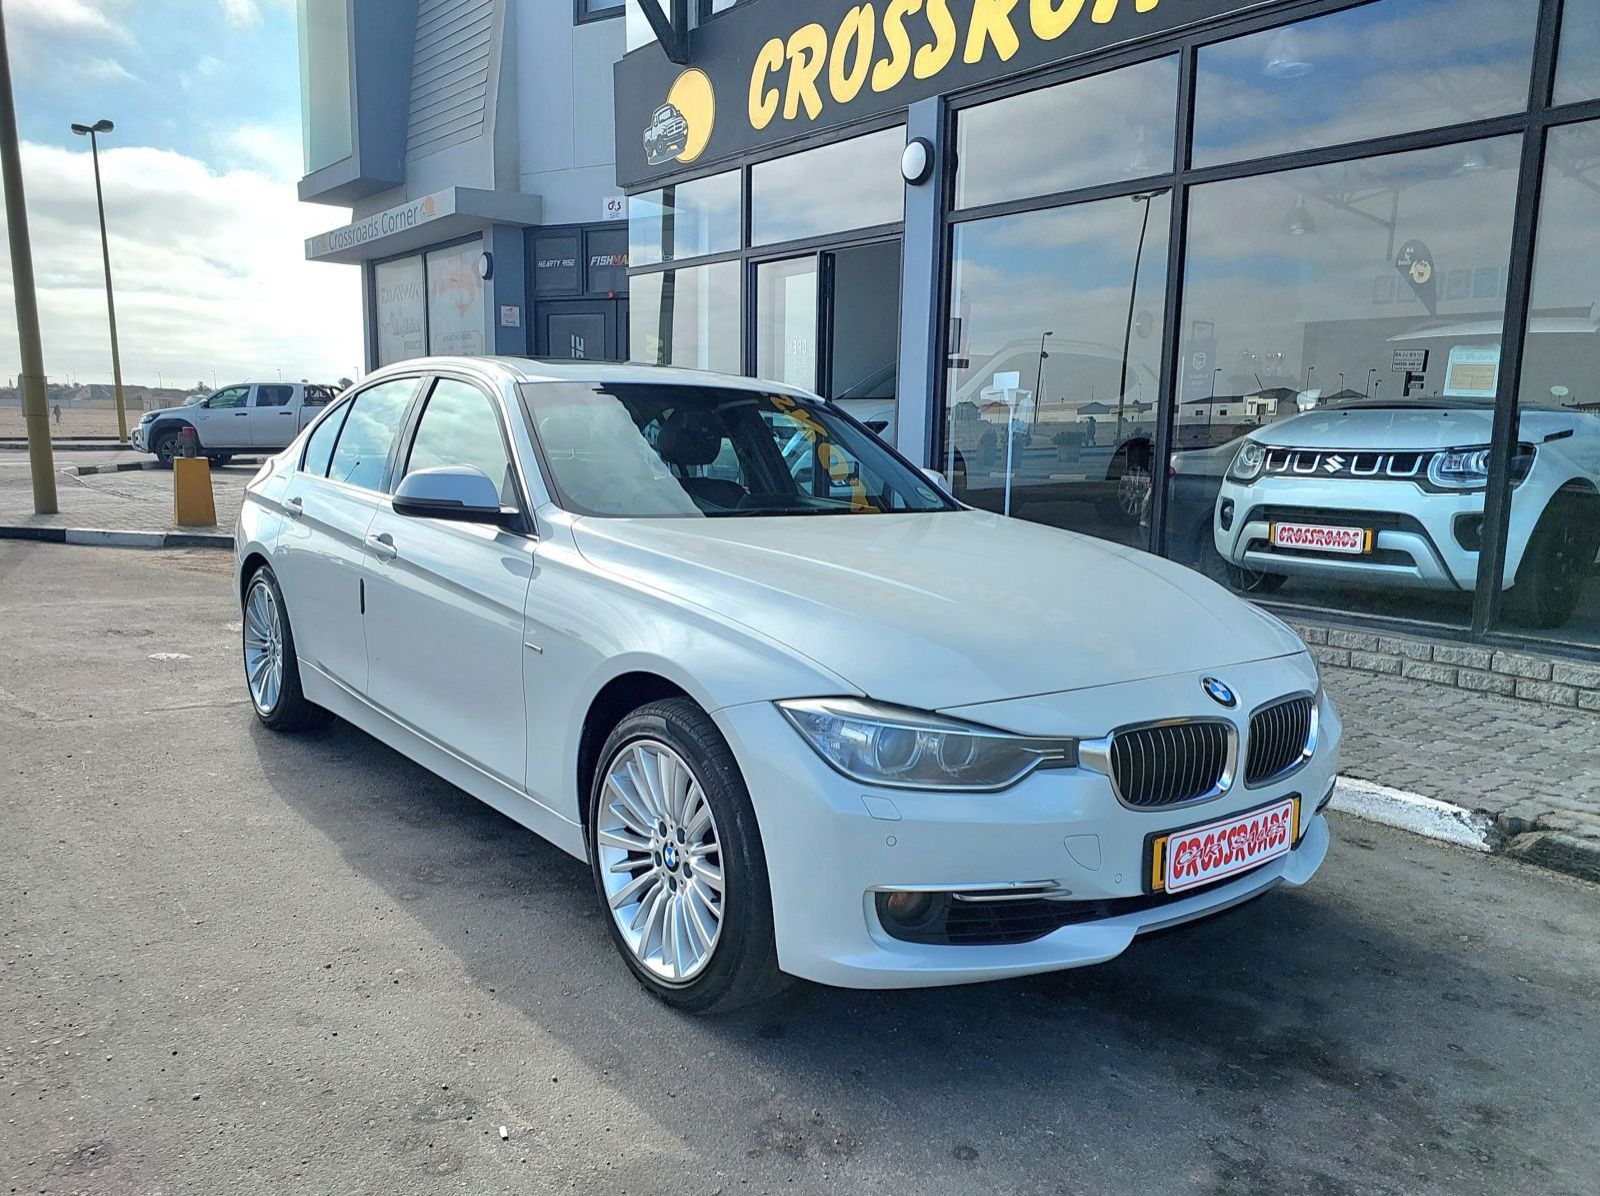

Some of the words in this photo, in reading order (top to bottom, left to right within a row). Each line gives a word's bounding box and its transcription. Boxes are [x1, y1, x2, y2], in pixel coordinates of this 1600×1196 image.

[748, 0, 1161, 131] CROSSR
[328, 217, 379, 250] Crossroads
[381, 205, 420, 234] Corner
[538, 259, 561, 268] HEARTY
[562, 258, 576, 267] RISE
[590, 254, 628, 266] FISHMA
[1278, 526, 1360, 548] CROSSROADS
[1173, 807, 1290, 879] CROSSROADS
[1176, 843, 1221, 867] CAR
[1231, 819, 1286, 850] SALES
